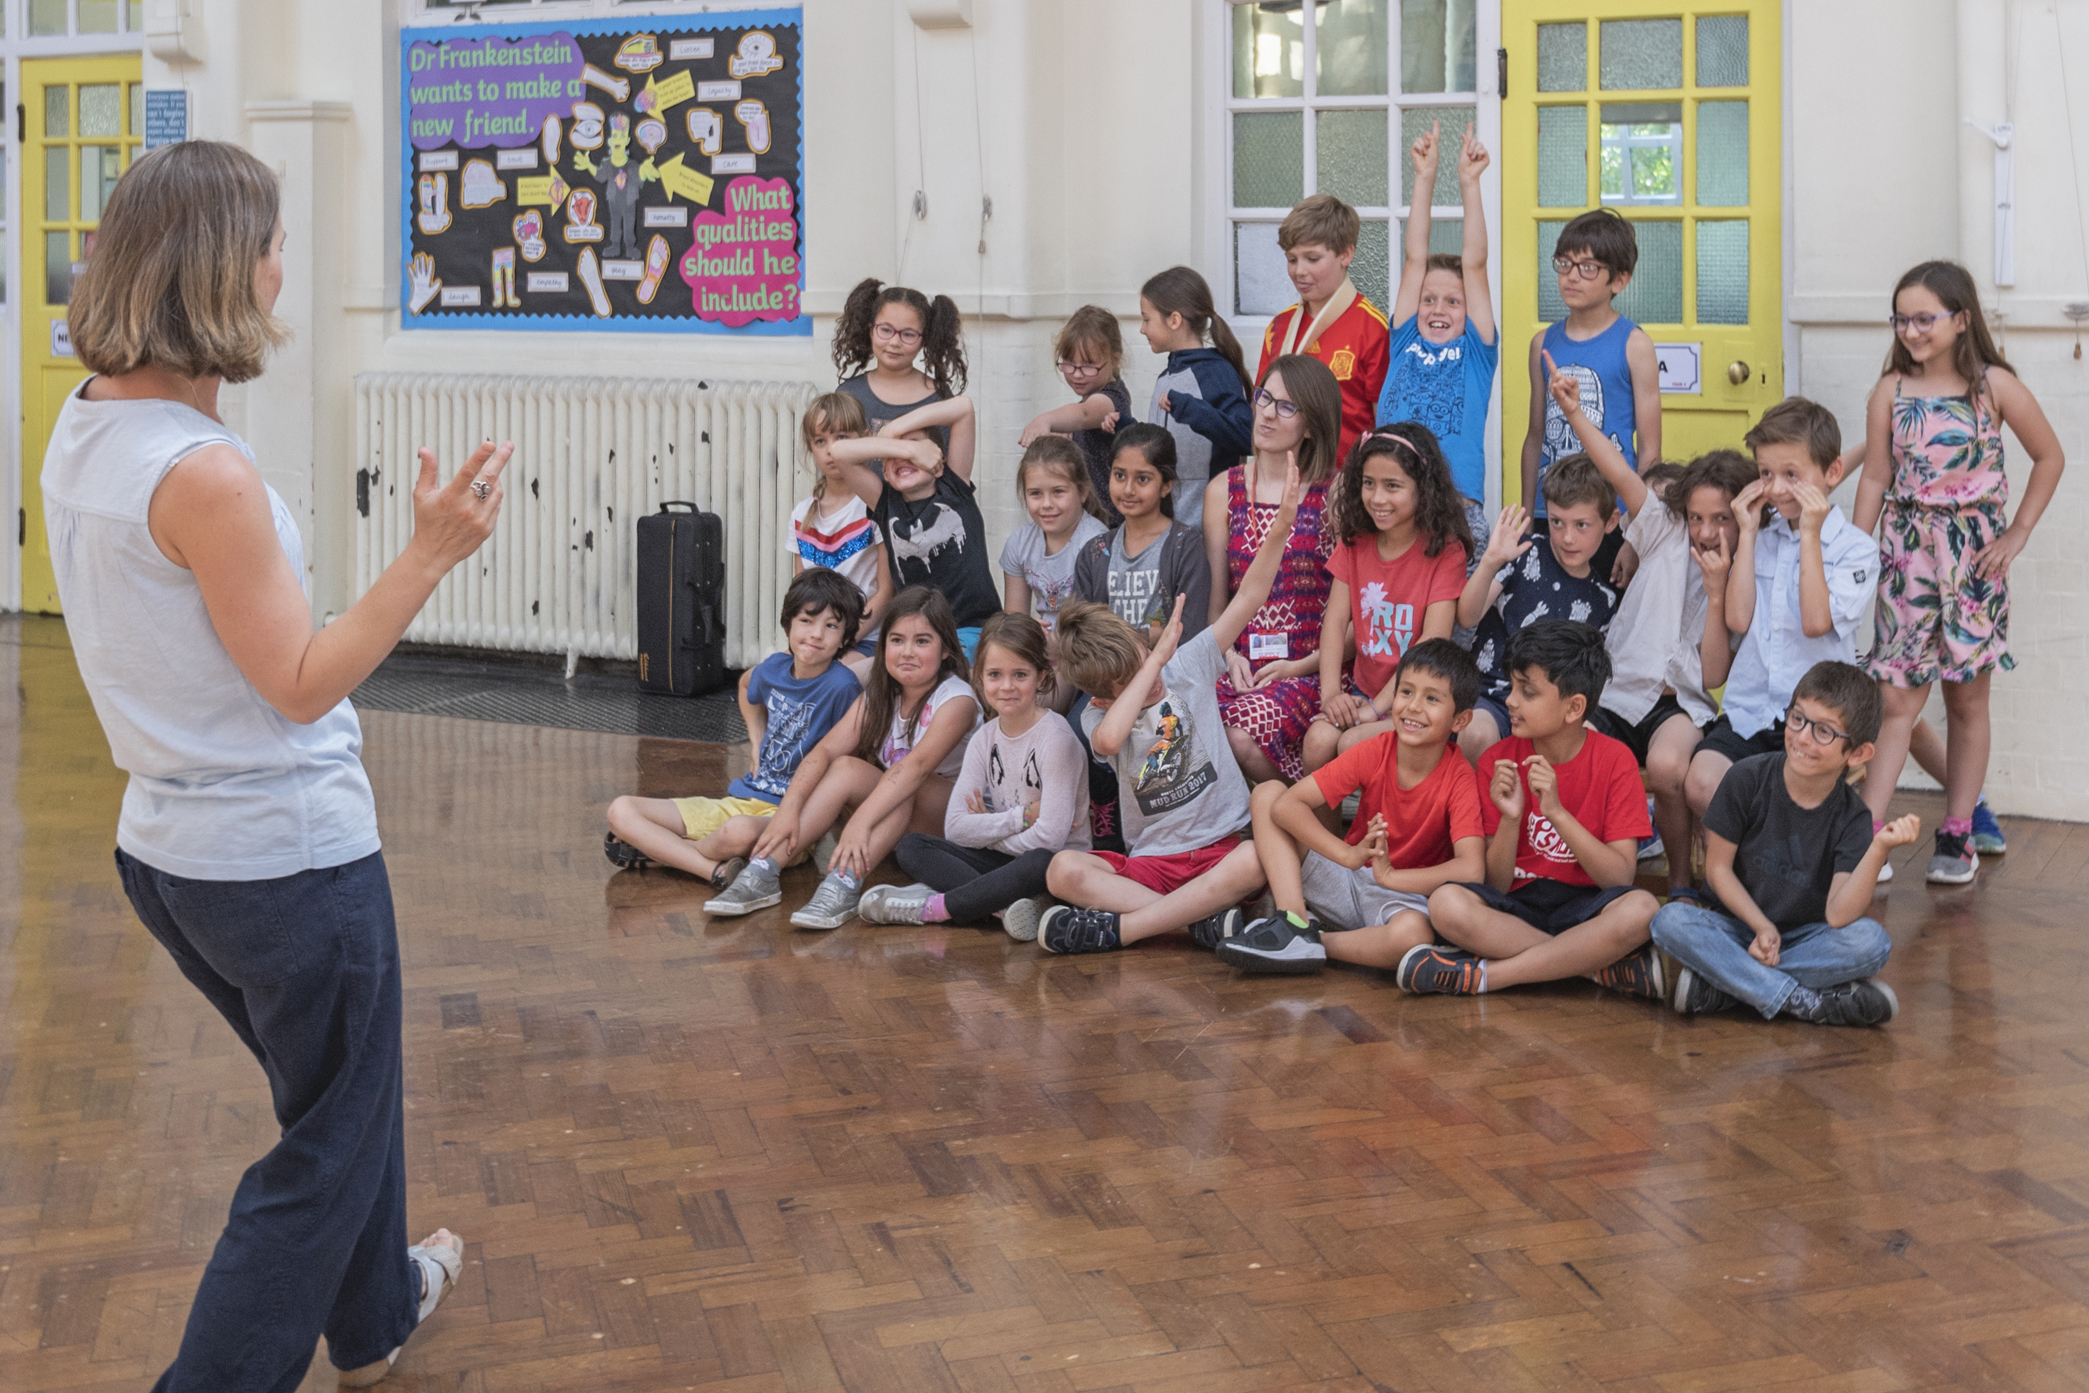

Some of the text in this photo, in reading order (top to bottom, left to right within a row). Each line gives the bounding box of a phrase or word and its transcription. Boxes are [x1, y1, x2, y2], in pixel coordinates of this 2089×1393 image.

[411, 40, 573, 72] Dr Frankenstein
[410, 72, 582, 105] wants to make a
[412, 108, 535, 144] new friend.
[730, 183, 792, 212] What
[696, 214, 794, 251] qualities
[685, 248, 796, 277] should he
[701, 283, 798, 312] include?
[1149, 796, 1171, 809] MUD
[1170, 786, 1189, 801] RUN
[1188, 771, 1208, 791] 2017
